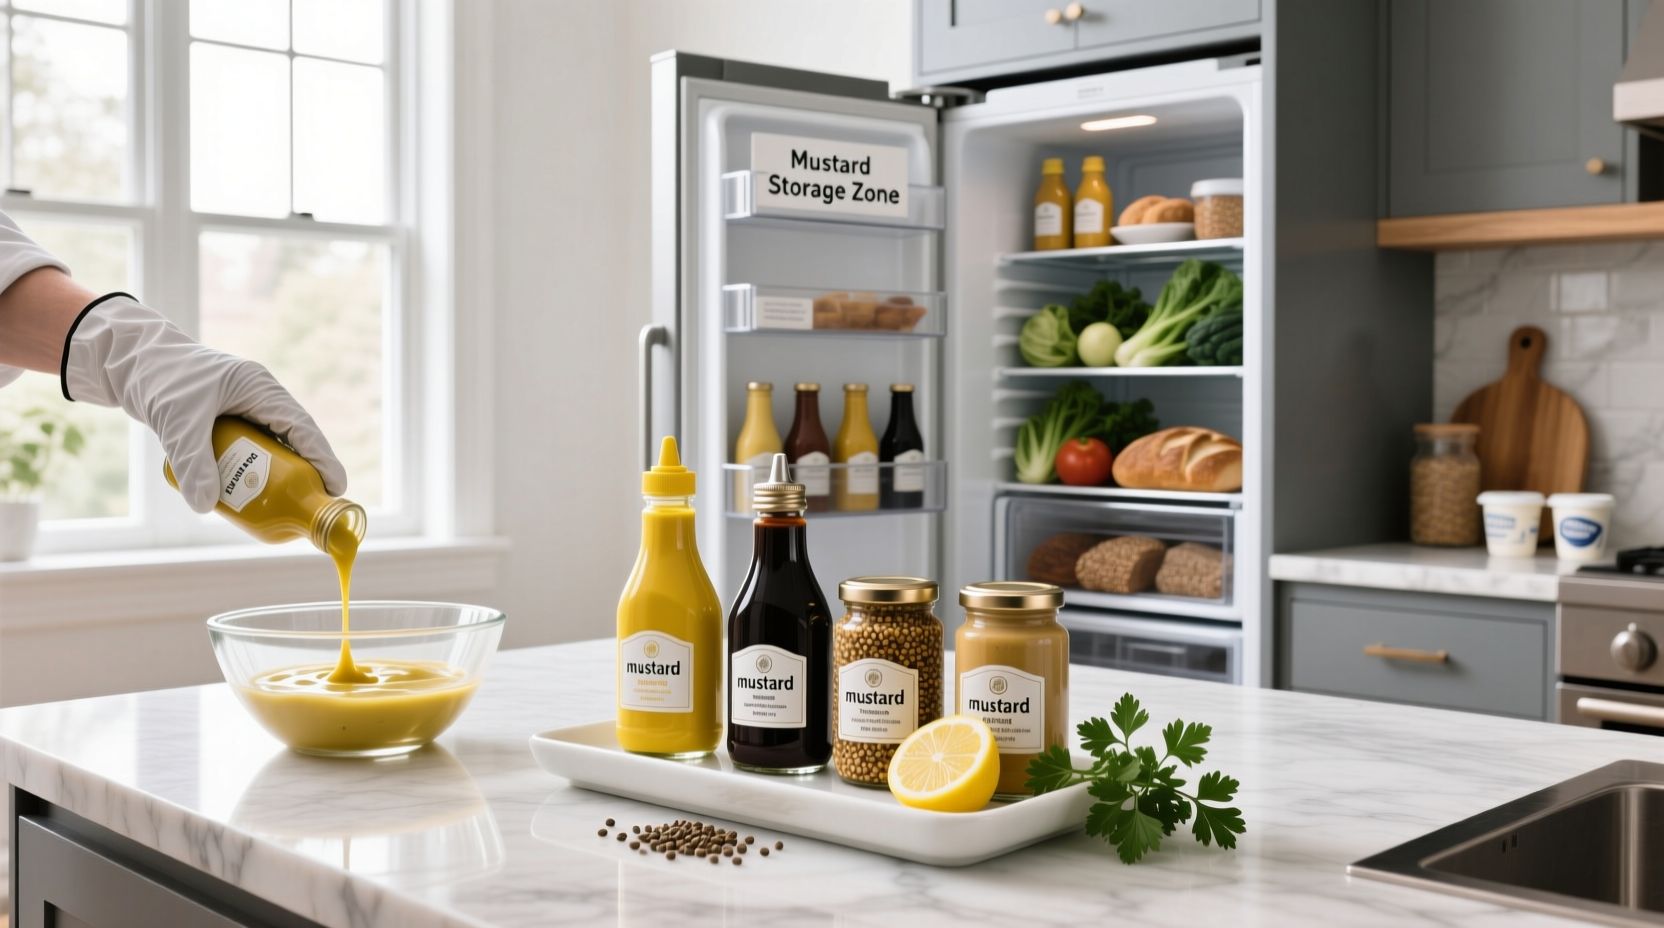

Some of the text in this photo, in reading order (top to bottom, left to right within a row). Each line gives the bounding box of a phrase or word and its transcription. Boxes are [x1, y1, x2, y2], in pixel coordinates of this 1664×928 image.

[791, 149, 870, 175] Mustard
[768, 174, 900, 204] Storage Zone
[627, 661, 681, 675] mustard
[737, 675, 794, 690] mustard
[845, 689, 905, 705] mustard
[969, 697, 1030, 713] mustard
